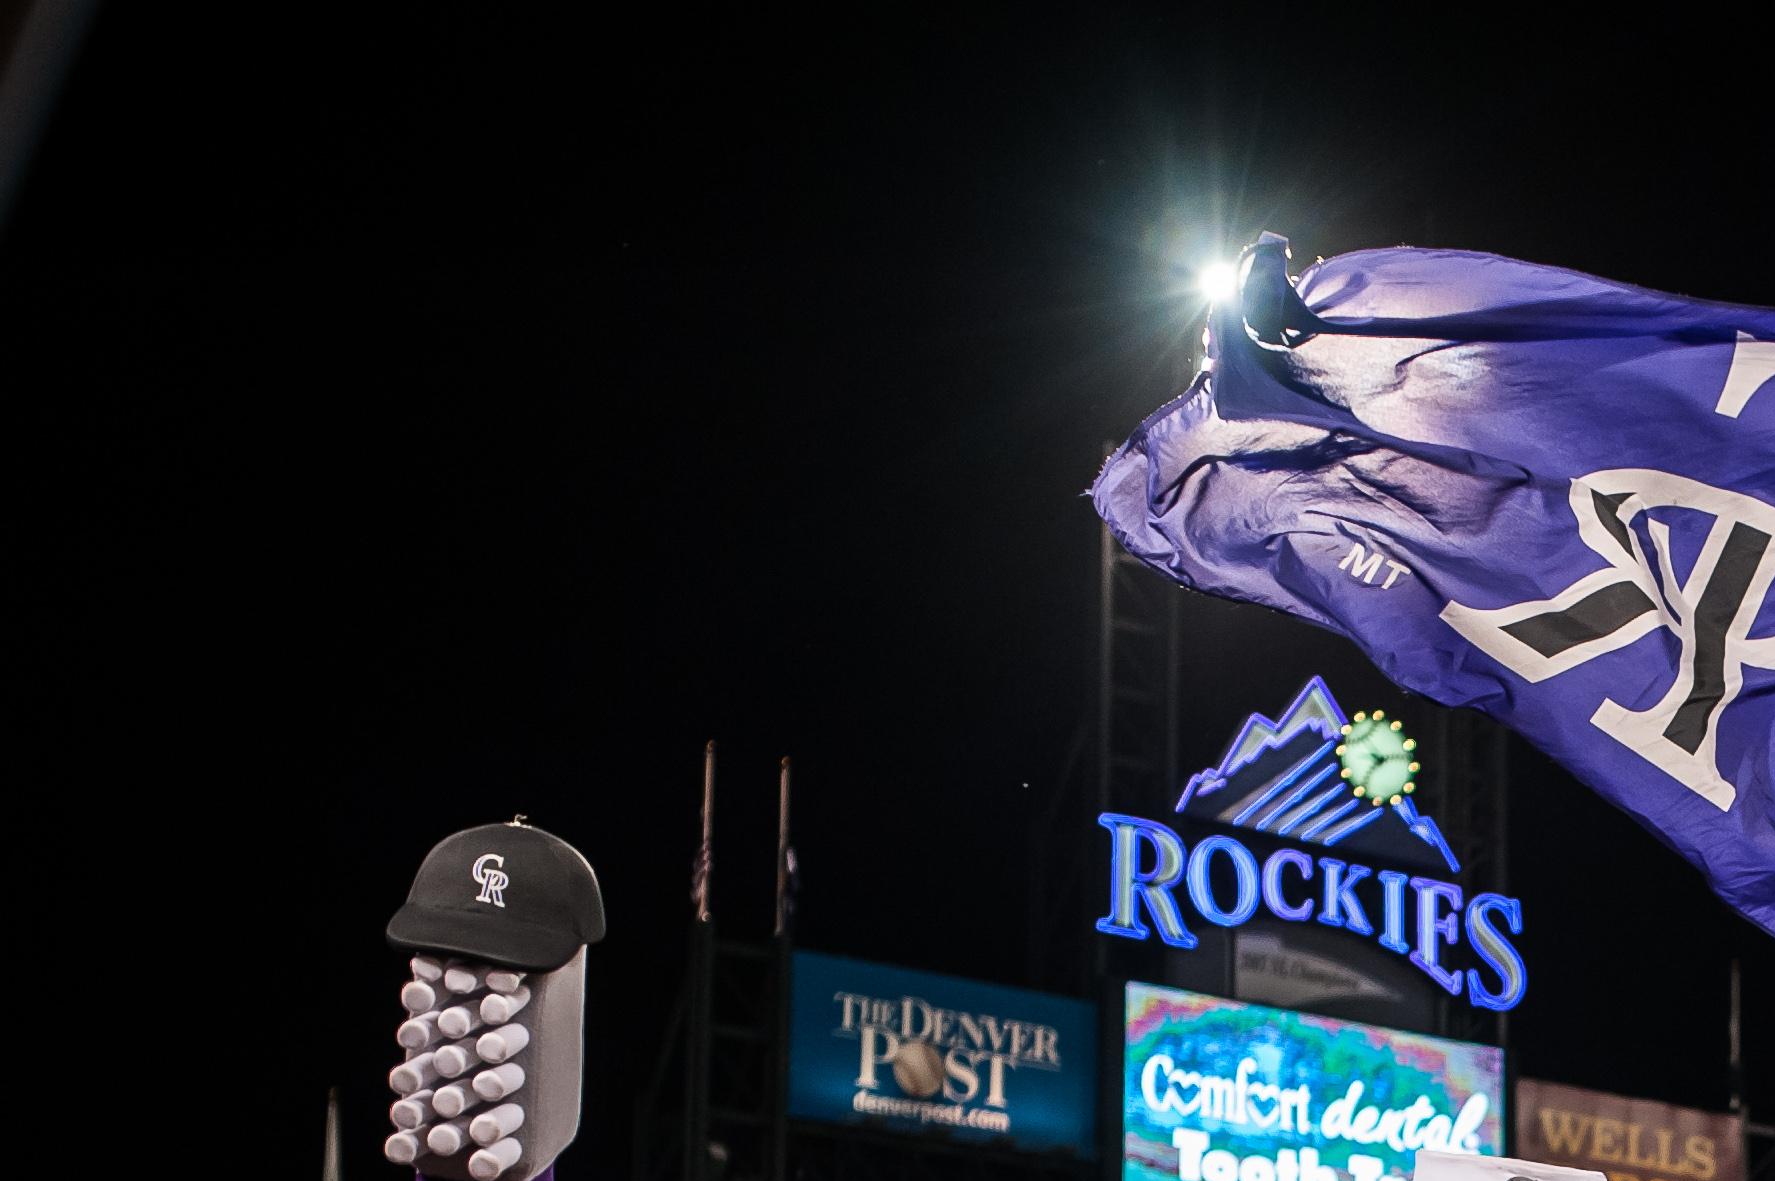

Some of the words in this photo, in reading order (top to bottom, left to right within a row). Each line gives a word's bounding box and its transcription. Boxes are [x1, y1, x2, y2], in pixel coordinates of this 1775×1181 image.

[1097, 812, 1527, 1011] ROCKIES
[834, 991, 897, 1037] THE
[901, 996, 1061, 1072] DENVER
[853, 1089, 1010, 1133] denverpost.com
[1320, 1079, 1489, 1154] dental
[1540, 1107, 1717, 1181] WELLS
